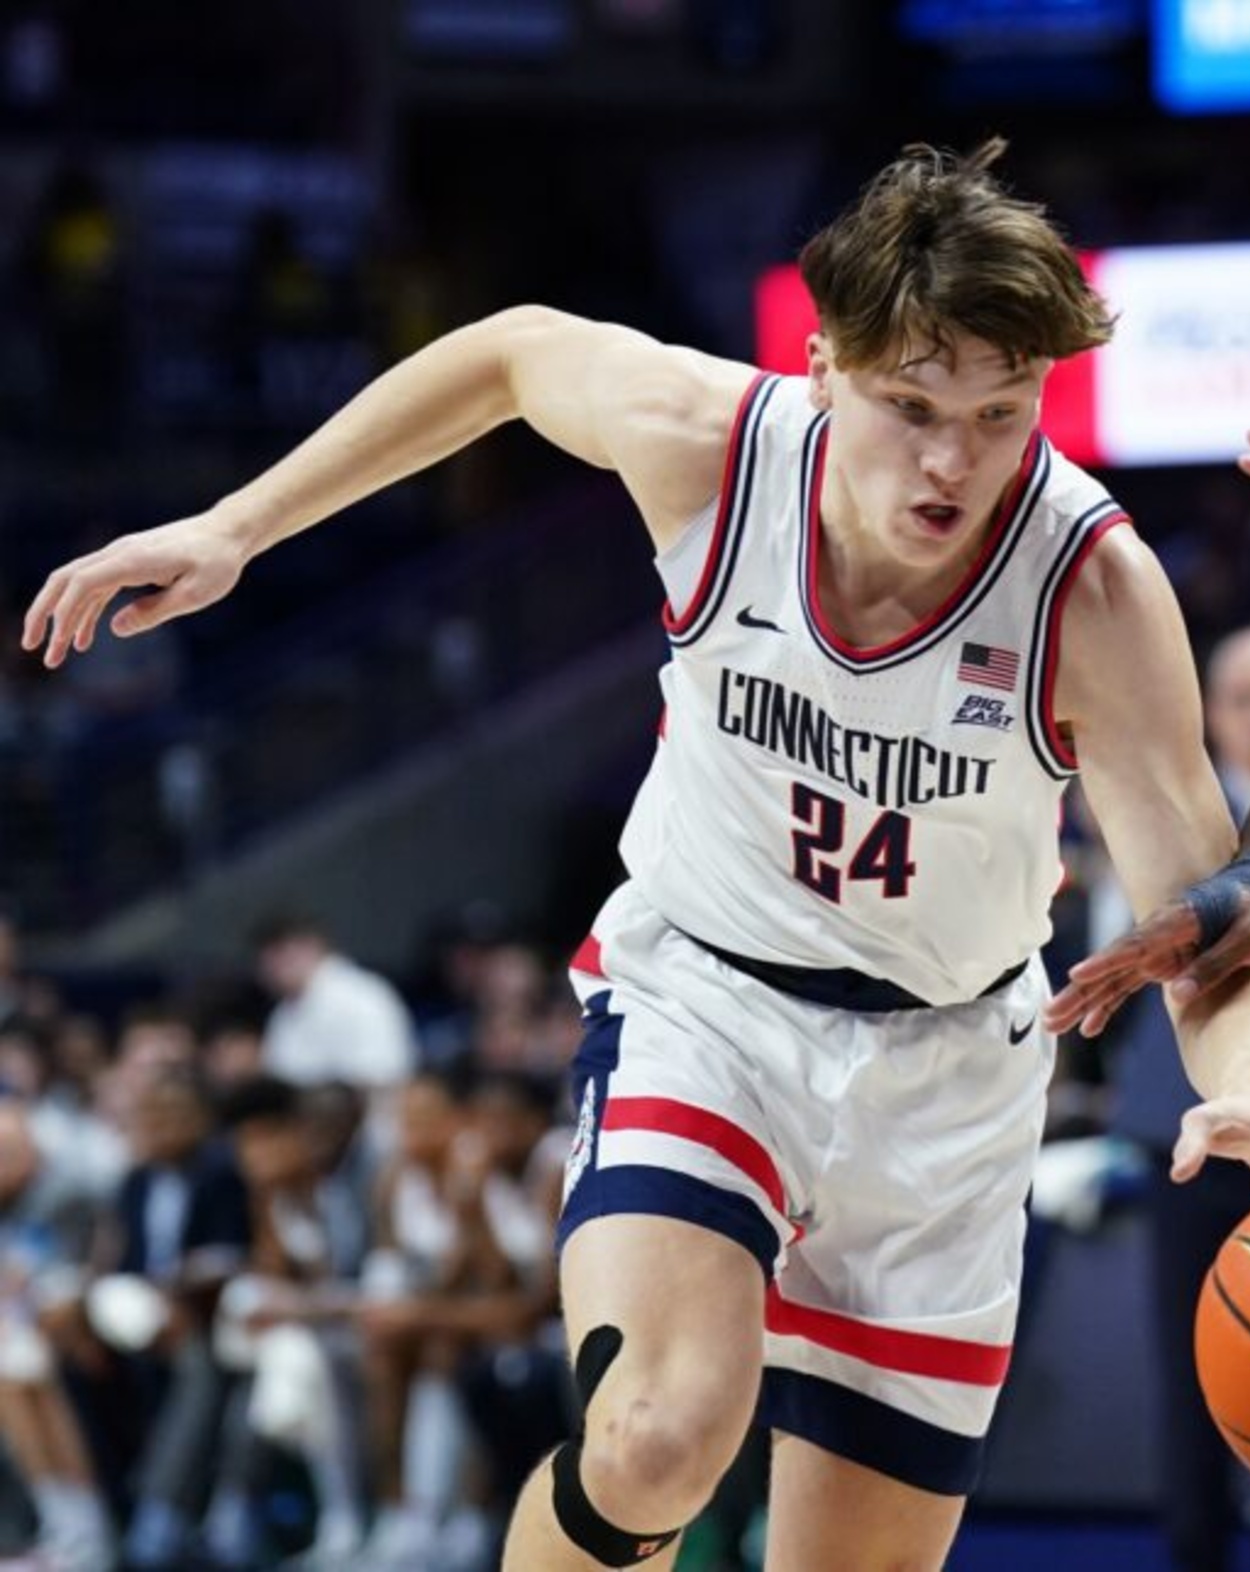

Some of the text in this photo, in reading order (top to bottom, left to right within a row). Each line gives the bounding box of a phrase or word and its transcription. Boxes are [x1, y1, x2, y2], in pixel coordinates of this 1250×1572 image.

[717, 667, 997, 809] CONNECTICUT
[954, 708, 1015, 727] EAST
[963, 695, 1006, 711] BIG
[790, 780, 917, 905] 24
